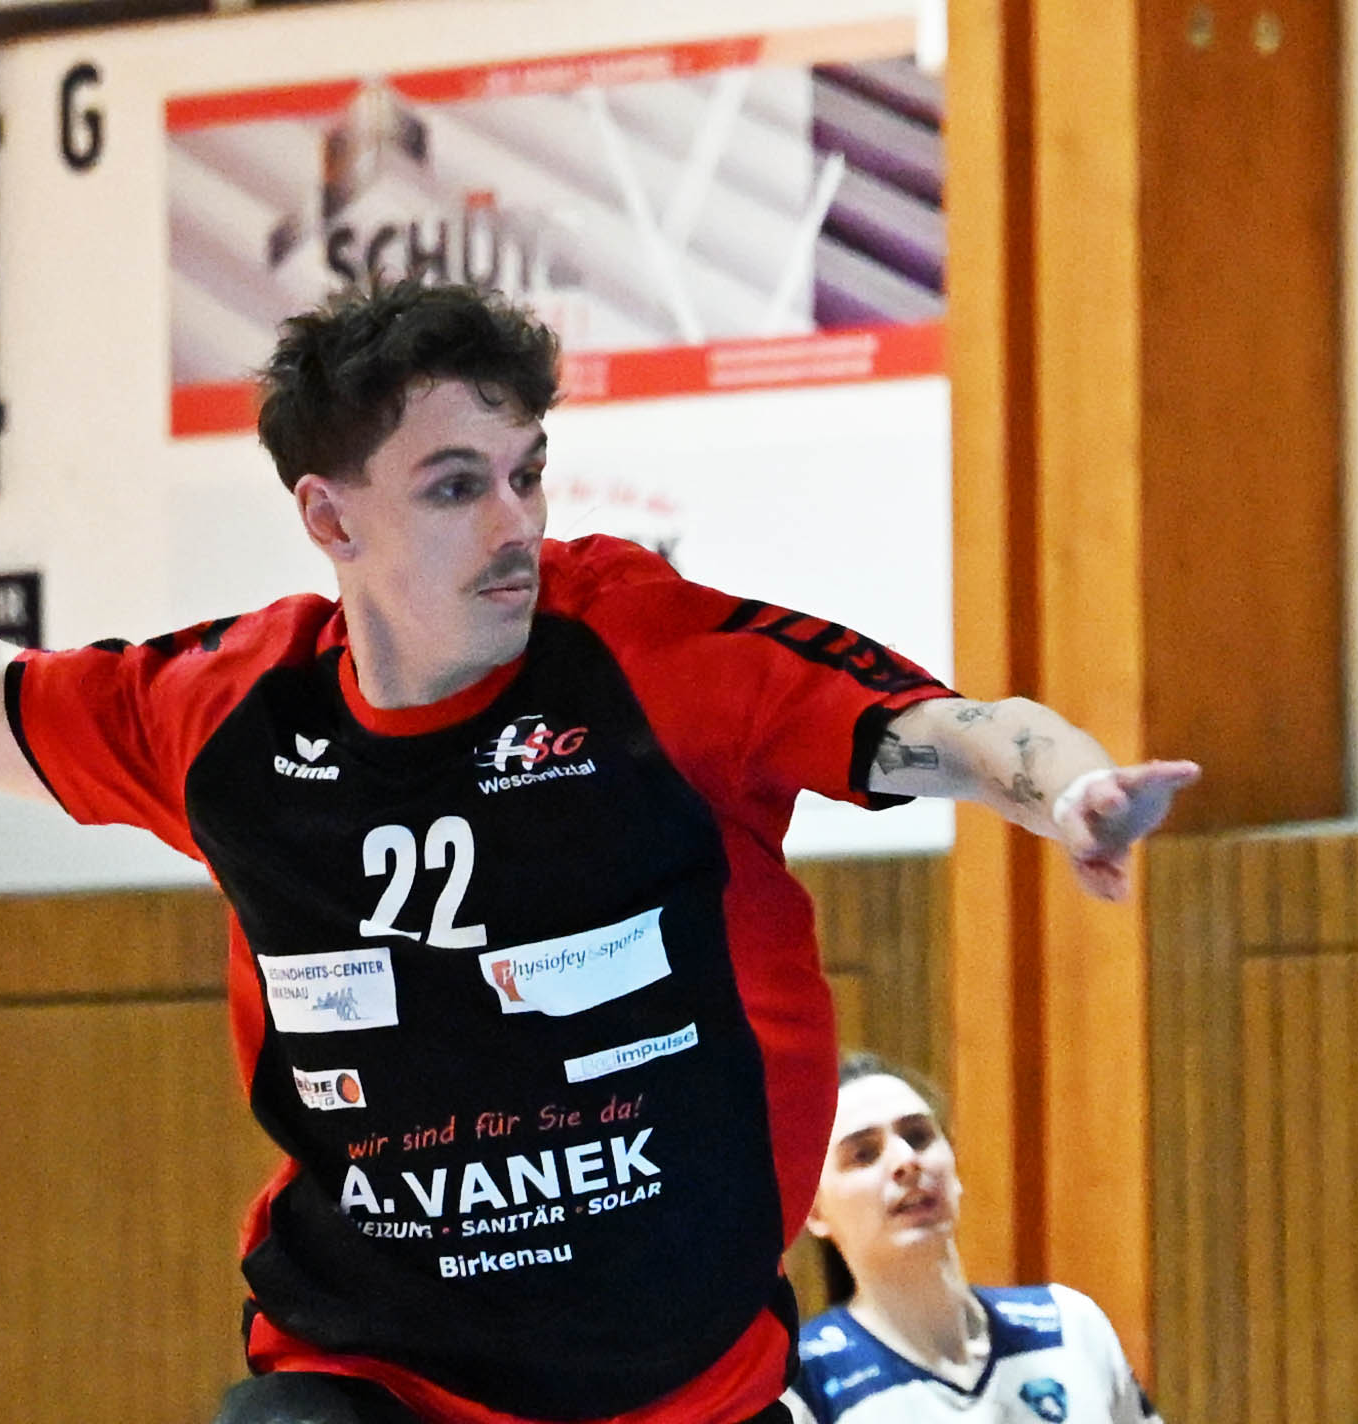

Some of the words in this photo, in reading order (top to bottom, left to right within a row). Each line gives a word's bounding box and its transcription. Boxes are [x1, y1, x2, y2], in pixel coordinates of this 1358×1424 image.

[59, 63, 103, 171] G
[274, 754, 340, 781] erima
[491, 722, 590, 772] HSG
[478, 758, 598, 796] Weschnitztal
[358, 815, 488, 949] 22
[600, 926, 645, 958] sports
[615, 1030, 695, 1065] impulse
[347, 1132, 389, 1160] wir
[402, 1115, 456, 1151] sind
[474, 1112, 521, 1140] für
[538, 1104, 581, 1131] Sie
[600, 1092, 644, 1125] da!
[461, 1204, 567, 1237] SANITÄR
[587, 1181, 663, 1216] SOLAR
[439, 1243, 574, 1279] Birkenau
